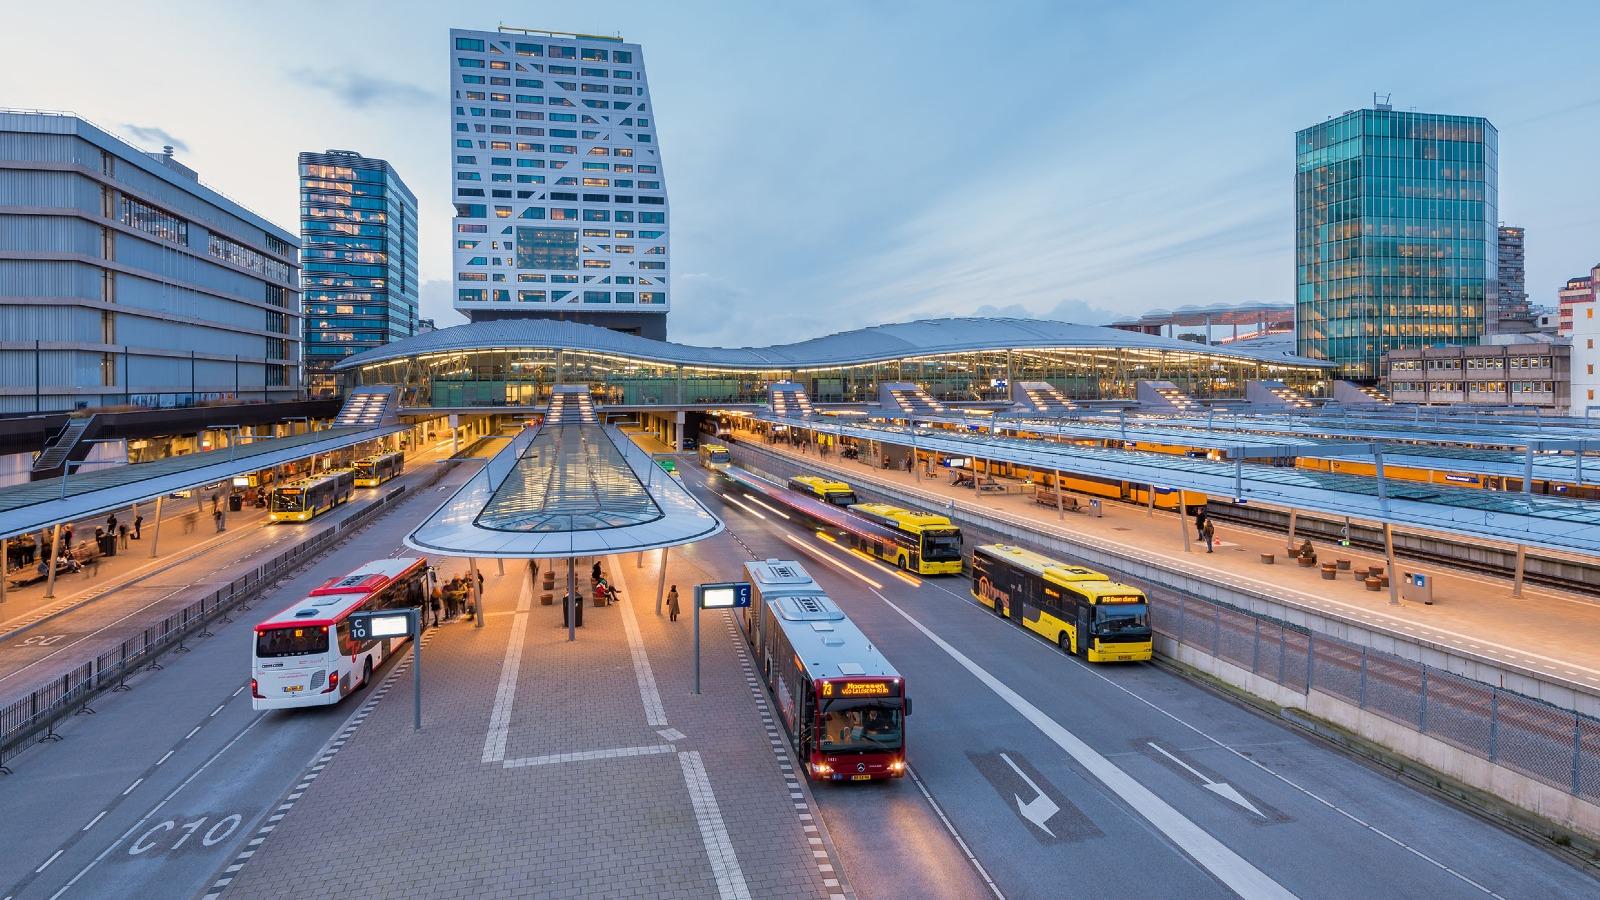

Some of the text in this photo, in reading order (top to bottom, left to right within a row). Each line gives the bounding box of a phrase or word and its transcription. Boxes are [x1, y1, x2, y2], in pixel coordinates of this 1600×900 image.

[740, 588, 747, 596] C
[354, 620, 363, 628] C
[351, 628, 366, 638] 10
[823, 683, 832, 695] 73
[128, 813, 243, 856] C10
